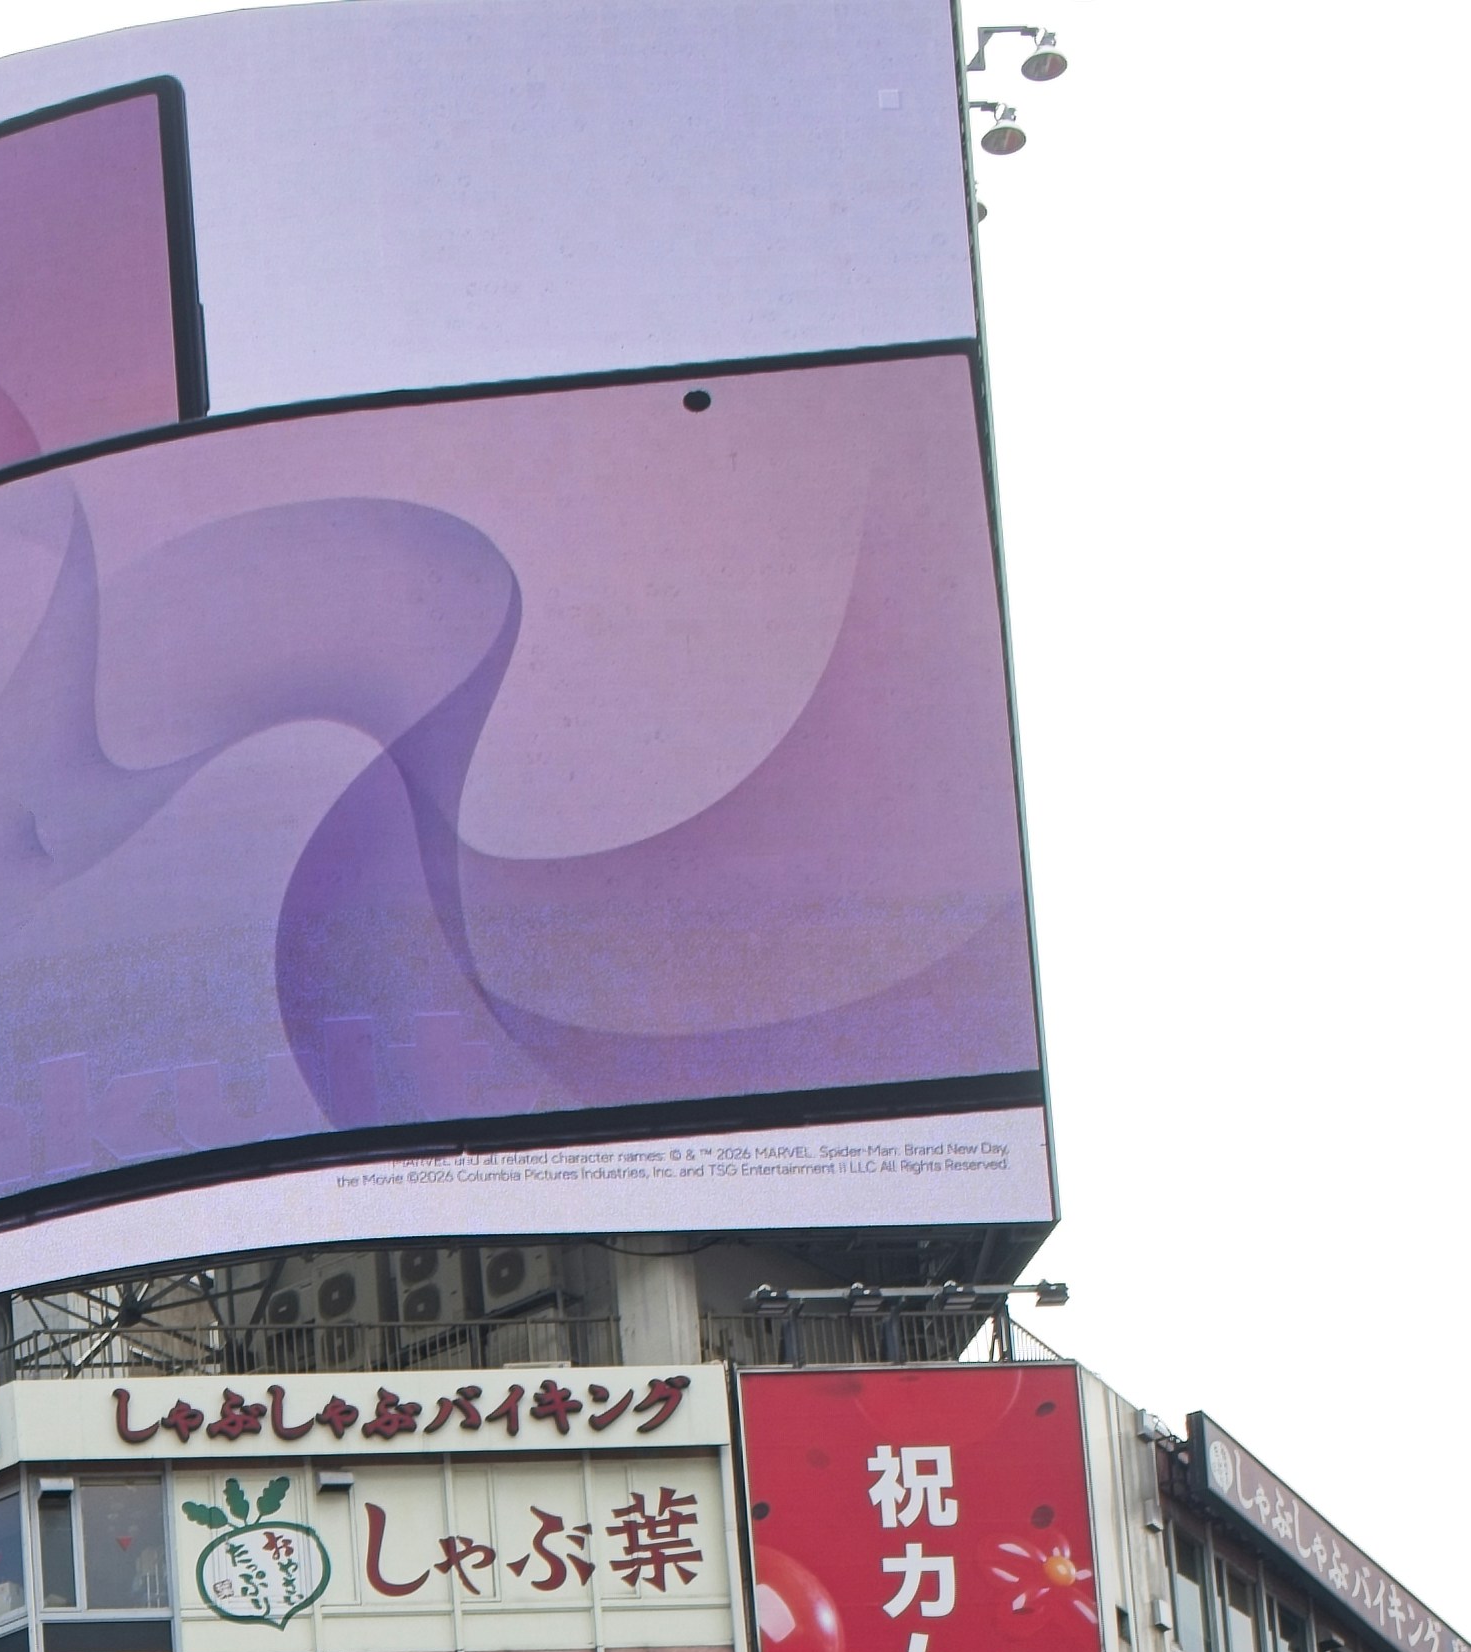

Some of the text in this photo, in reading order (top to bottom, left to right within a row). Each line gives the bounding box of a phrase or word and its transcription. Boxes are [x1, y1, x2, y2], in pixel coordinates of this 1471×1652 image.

[456, 1167, 521, 1184] Columbia
[524, 1166, 579, 1183] Pictures
[679, 1163, 704, 1178] and
[741, 1160, 836, 1178] Entertainment
[900, 1158, 942, 1176] Rights
[501, 1150, 548, 1165] related
[551, 1148, 615, 1165] character
[716, 1145, 751, 1161] 2026
[904, 1141, 944, 1157] Brand
[947, 1141, 978, 1157] New
[112, 1376, 692, 1446] しゃぶしゃぶバイキング
[363, 1488, 705, 1599] しゃぶ葉
[225, 1543, 271, 1618] たっぷり
